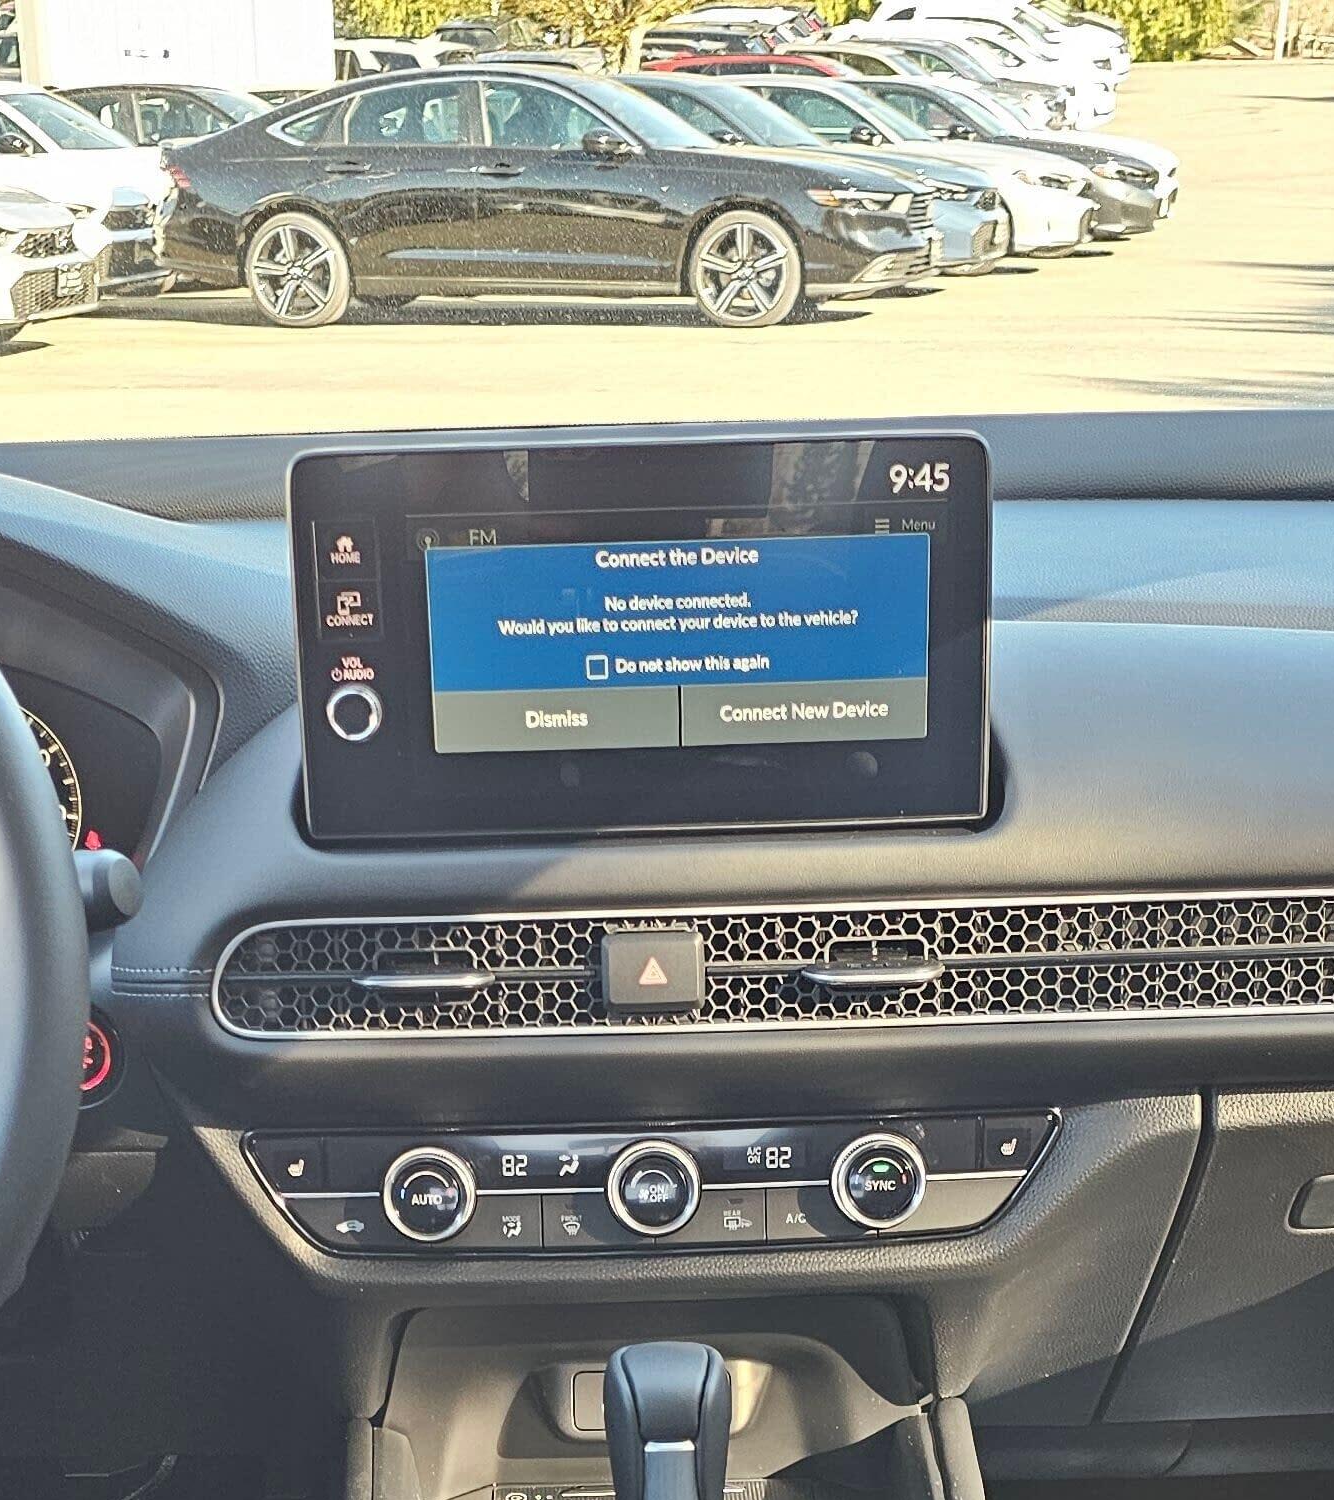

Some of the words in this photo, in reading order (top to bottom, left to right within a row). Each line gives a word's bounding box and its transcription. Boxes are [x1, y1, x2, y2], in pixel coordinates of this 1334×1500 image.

[890, 463, 950, 493] 9:45
[901, 518, 936, 531] Menu
[469, 529, 497, 546] FM
[330, 552, 361, 565] HOME
[595, 550, 666, 568] Connect
[669, 548, 697, 566] the
[701, 547, 759, 565] Device
[604, 596, 627, 612] No
[629, 595, 673, 611] device
[676, 591, 751, 609] connected.
[326, 613, 375, 627] CONNECT
[497, 618, 545, 636] Would
[547, 620, 574, 637] you
[576, 617, 601, 633] like
[603, 617, 618, 632] to
[621, 615, 676, 631] connect
[679, 614, 710, 633] your
[713, 613, 757, 629] device
[760, 612, 775, 628] to
[778, 611, 801, 627] the
[803, 608, 859, 626] vehicle?
[341, 656, 364, 669] VOL
[615, 658, 636, 674] Do
[639, 658, 662, 673] not
[665, 656, 702, 673] show
[704, 655, 730, 671] this
[733, 653, 770, 672] again
[344, 668, 375, 681] AUDIO
[525, 710, 588, 728] Dismiss
[720, 704, 787, 723] Connect
[792, 702, 828, 721] New
[833, 700, 889, 719] Device
[746, 1147, 761, 1156] A/C
[765, 1146, 792, 1169] 82
[747, 1155, 761, 1164] ON
[501, 1154, 528, 1177] 82
[864, 1180, 897, 1192] SYNC
[411, 1195, 443, 1207] AUTO
[649, 1193, 669, 1203] OFF
[786, 1213, 806, 1224] A/C
